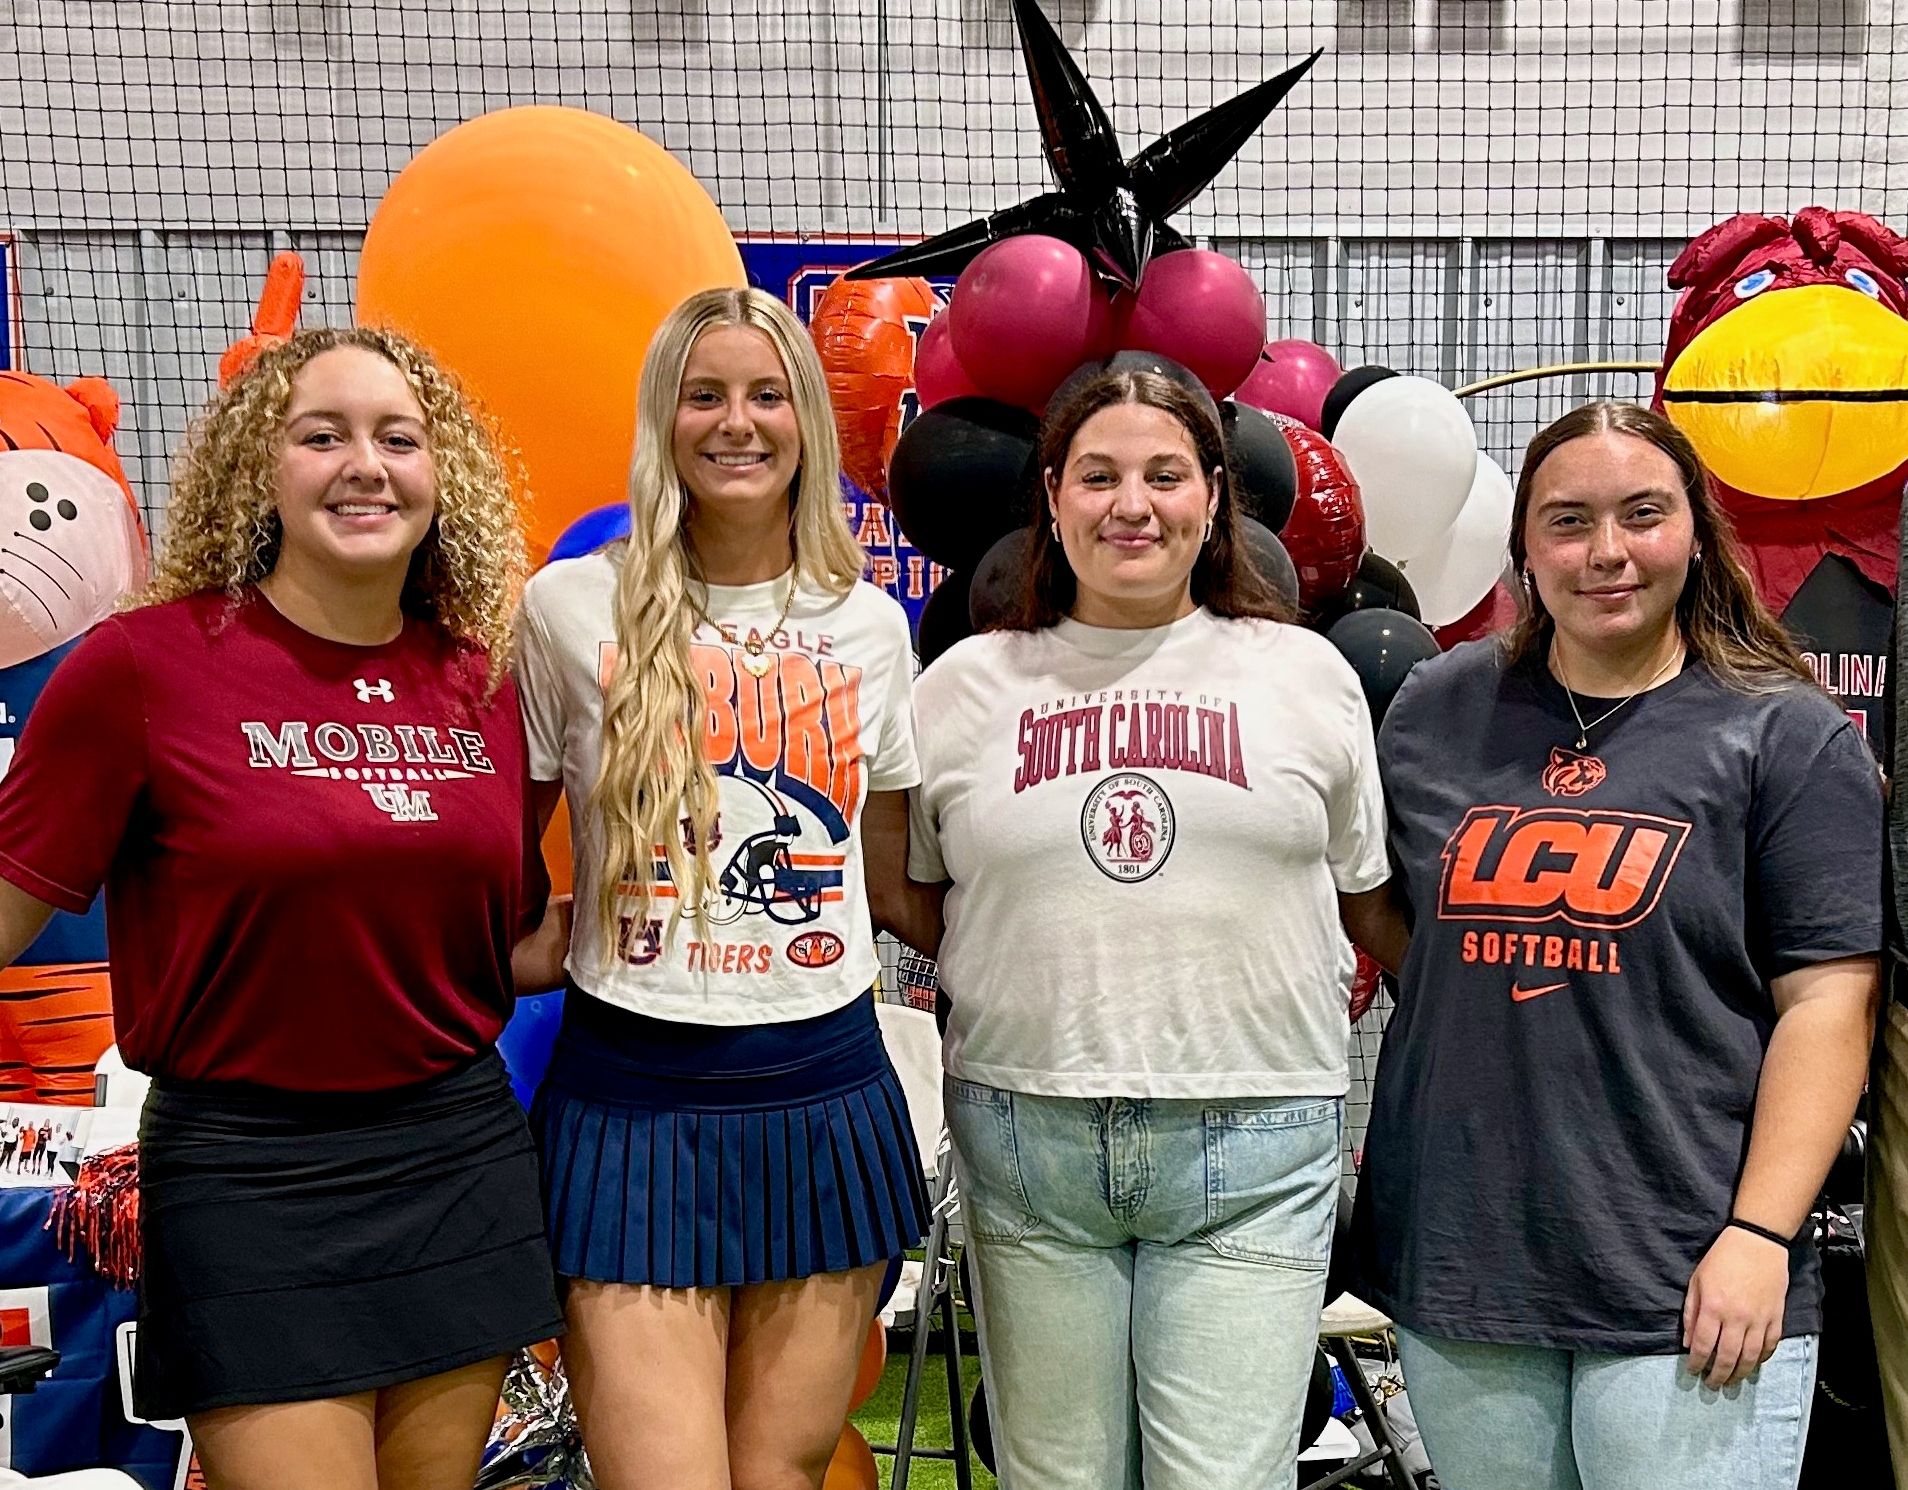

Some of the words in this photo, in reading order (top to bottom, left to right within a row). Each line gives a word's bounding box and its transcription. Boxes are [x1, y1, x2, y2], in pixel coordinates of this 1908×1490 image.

[720, 623, 835, 657] EAGLE
[1040, 689, 1183, 714] UNIVERSITY
[1199, 694, 1222, 708] OF
[241, 721, 496, 774] MOBILE
[599, 640, 864, 829] BURN
[1014, 705, 1103, 794] SOUTH
[1108, 702, 1248, 790] CAROLINA
[329, 766, 447, 781] SOFTBALL
[1118, 864, 1141, 874] 1801
[1442, 809, 1684, 923] LCU
[686, 942, 774, 974] TIGERS
[1461, 930, 1622, 974] SOFTBALL
